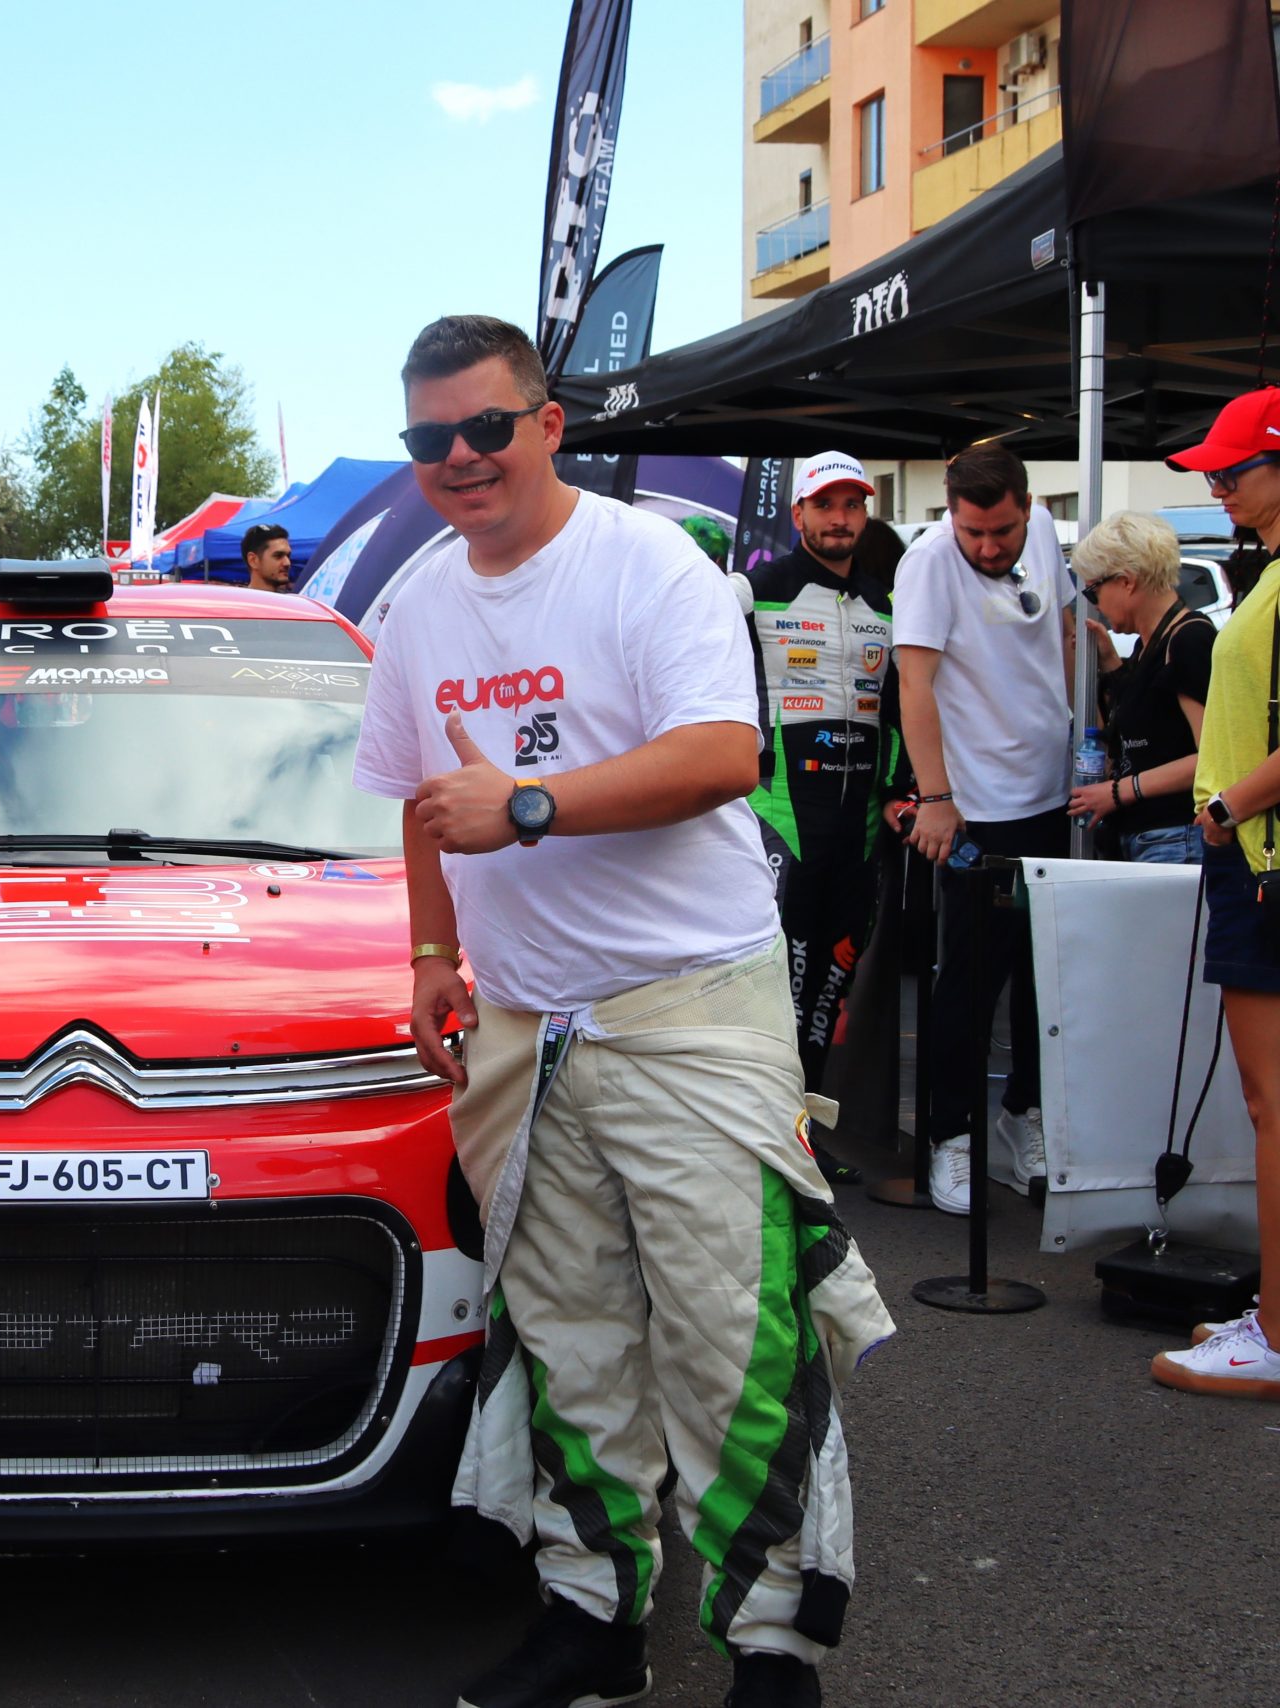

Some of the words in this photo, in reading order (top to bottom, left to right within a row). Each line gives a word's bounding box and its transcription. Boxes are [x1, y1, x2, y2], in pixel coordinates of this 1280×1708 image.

[776, 620, 825, 631] NetBet
[851, 624, 887, 635] YACCO
[867, 650, 880, 660] BT
[435, 665, 564, 718] europa
[499, 683, 515, 698] fm
[784, 698, 821, 708] KUHN
